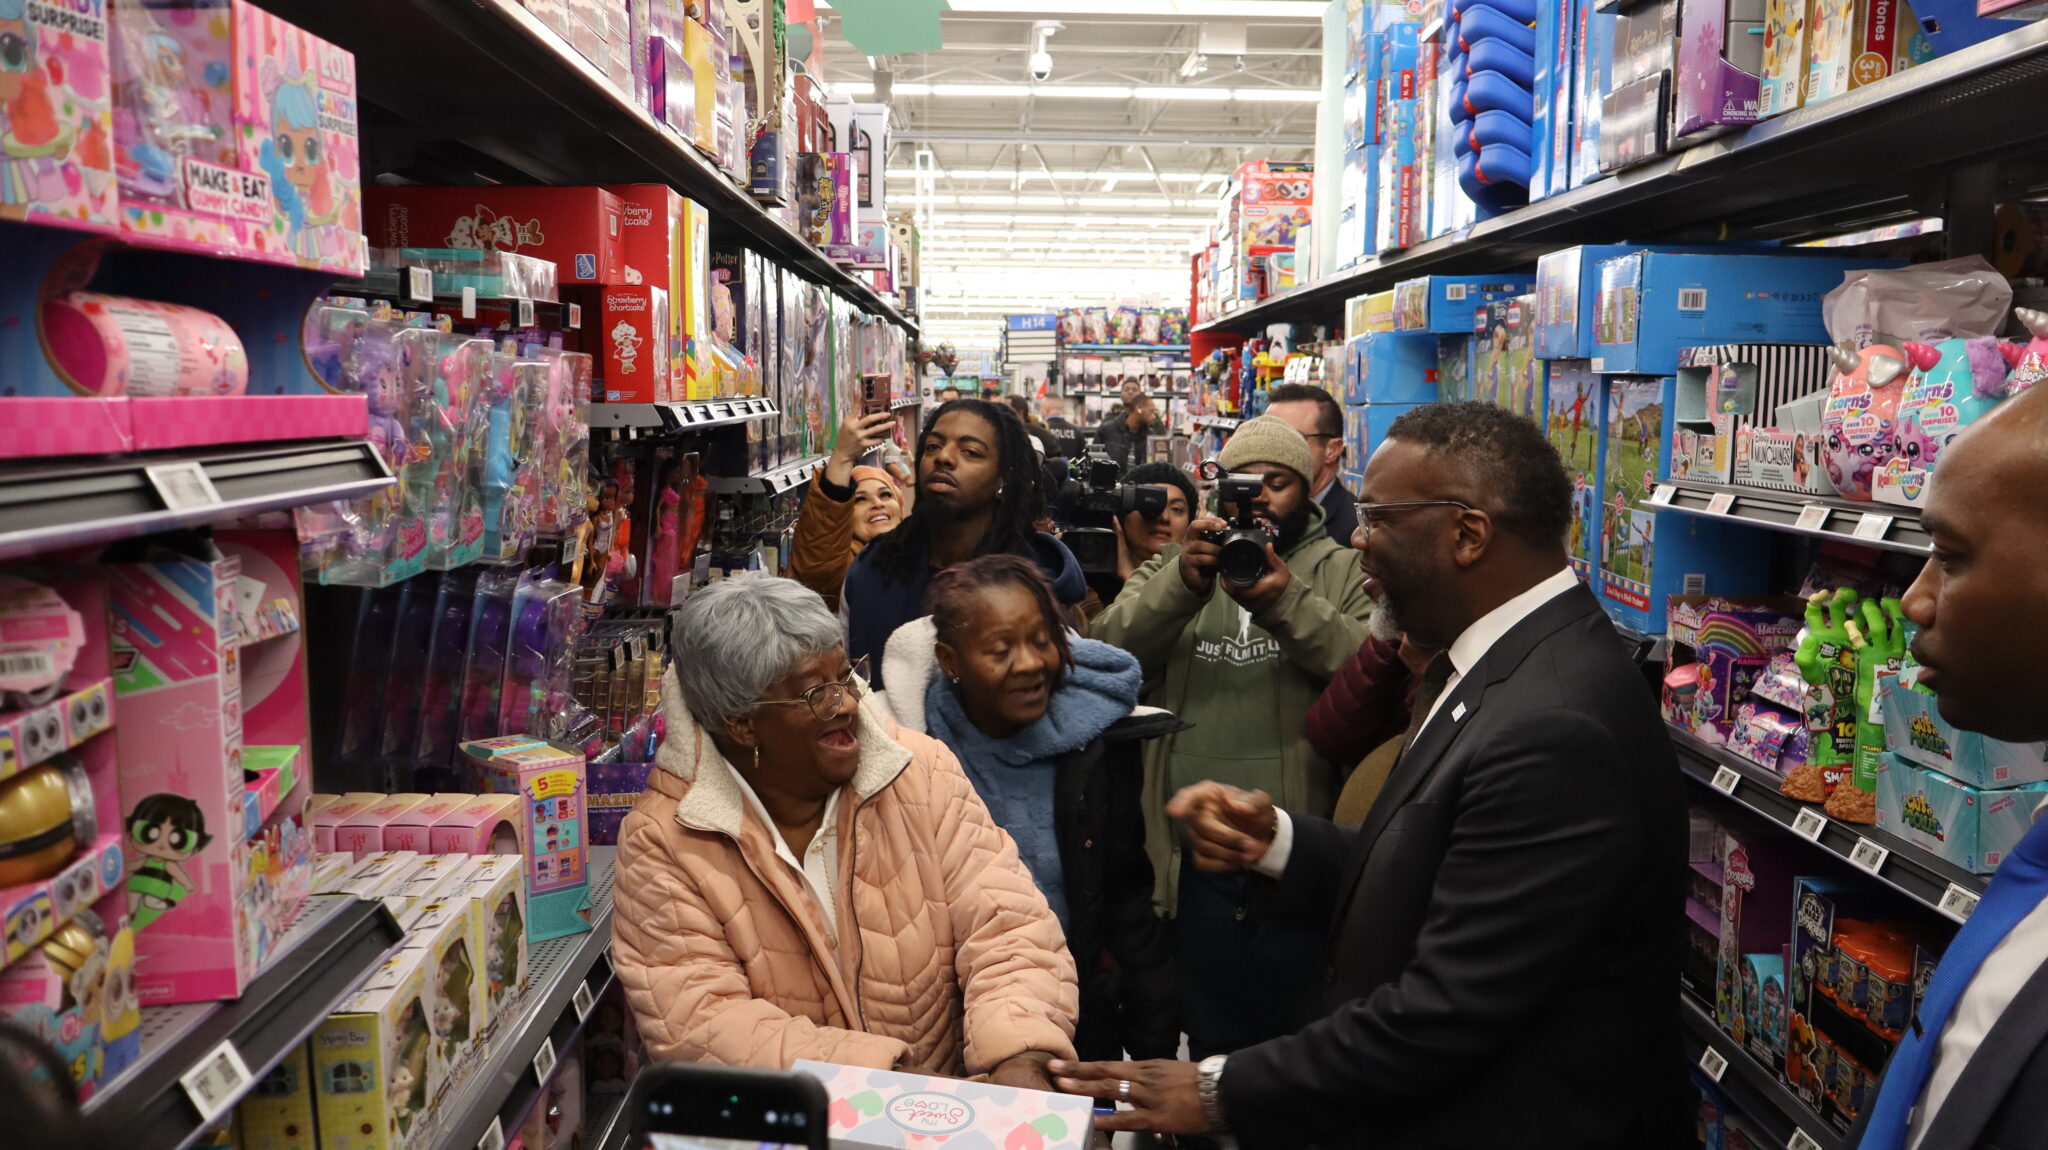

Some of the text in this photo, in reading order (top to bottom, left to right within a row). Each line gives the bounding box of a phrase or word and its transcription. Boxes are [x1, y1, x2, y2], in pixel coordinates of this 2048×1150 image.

[1875, 0, 1887, 41] tones
[1859, 59, 1874, 82] 3+
[1744, 100, 1758, 110] WA
[190, 163, 266, 201] MAKE & EAT
[624, 205, 654, 220] berry
[624, 216, 651, 227] tcake
[607, 295, 647, 307] Strawberry
[609, 304, 645, 312] Shortcake
[1021, 316, 1046, 329] H14
[1939, 405, 1955, 417] 10
[1861, 416, 1875, 427] 10
[1921, 417, 1958, 426] SURPRISES
[1754, 445, 1791, 466] MUNCHLINGS
[1878, 471, 1926, 488] Rainbocorns
[1225, 643, 1251, 661] FILM
[1887, 658, 1901, 671] SM
[1836, 722, 1856, 738] 10
[537, 777, 549, 791] 5
[587, 792, 640, 808] MAZIN
[1804, 901, 1820, 915] STAR
[1804, 907, 1820, 923] WARS
[894, 1106, 964, 1125] Sweet
[920, 1118, 938, 1127] my
